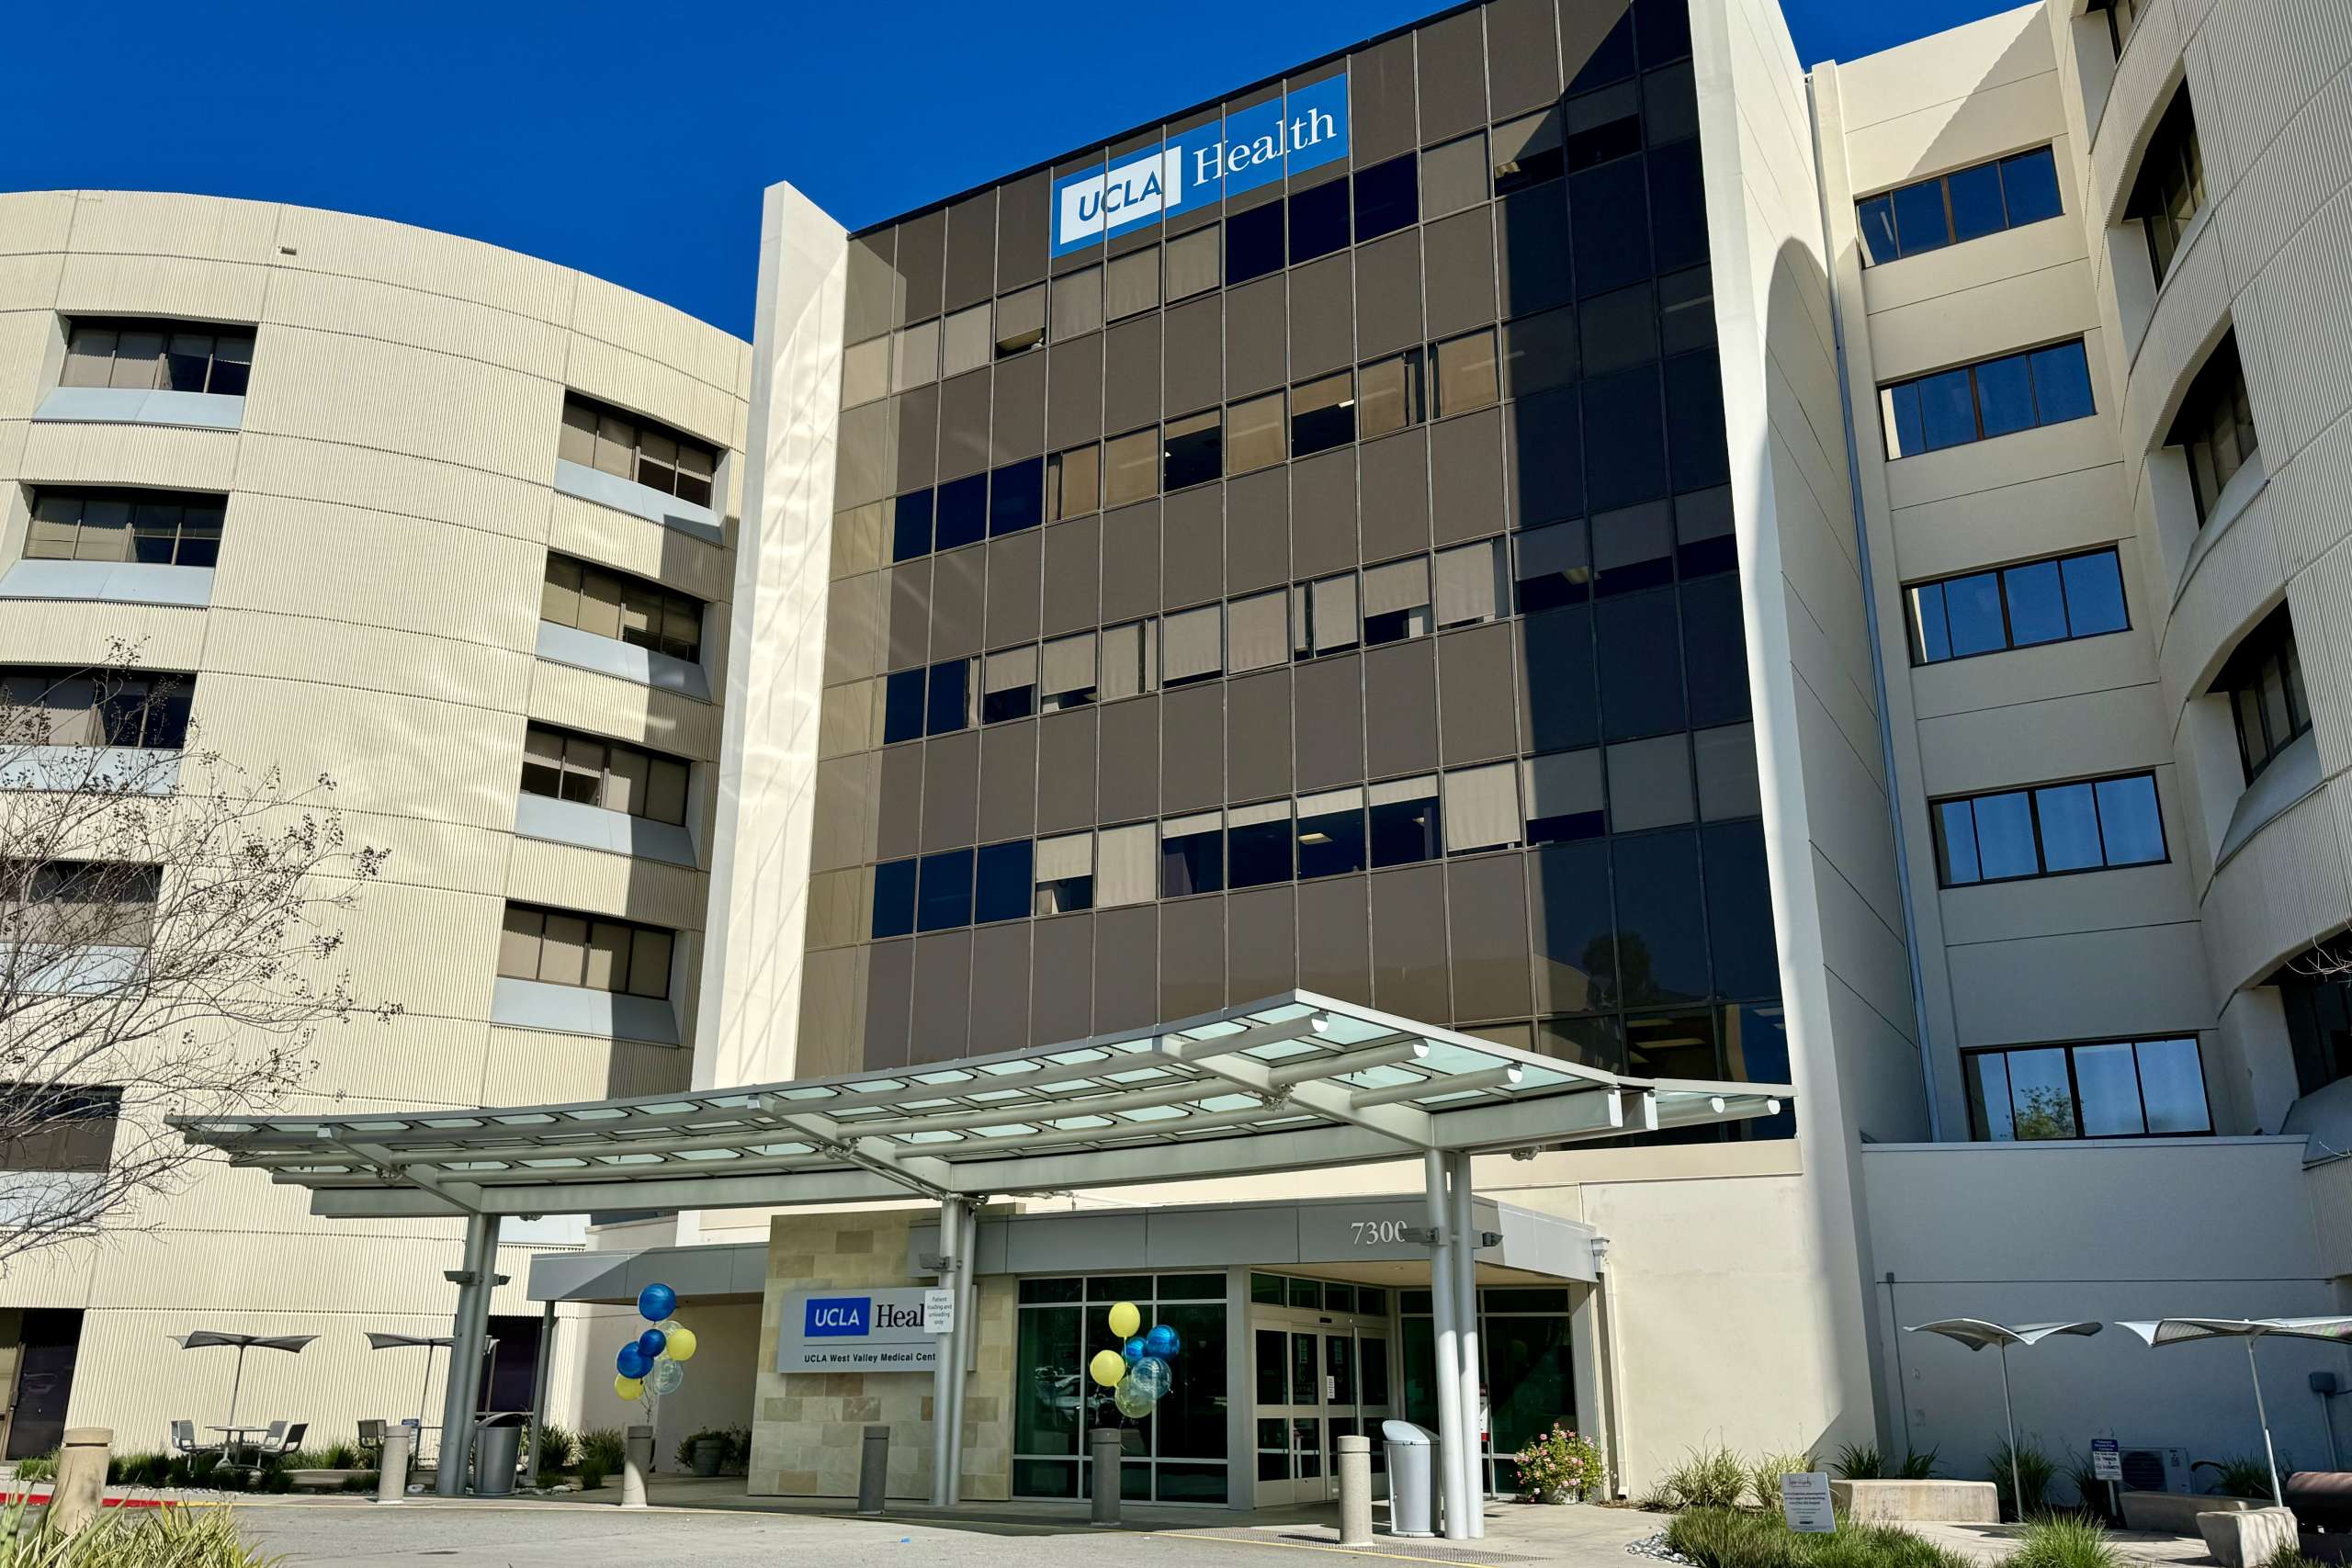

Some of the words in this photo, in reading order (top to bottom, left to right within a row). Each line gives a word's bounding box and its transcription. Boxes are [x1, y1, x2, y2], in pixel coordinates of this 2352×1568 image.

[1078, 170, 1163, 222] UCLA
[1192, 107, 1338, 186] Health
[814, 1307, 861, 1327] UCLA
[875, 1303, 925, 1328] Heal
[804, 1354, 827, 1363] UCLA
[830, 1354, 851, 1362] West
[853, 1352, 878, 1363] Valley
[880, 1352, 913, 1361] Medical
[915, 1352, 936, 1361] Cent
